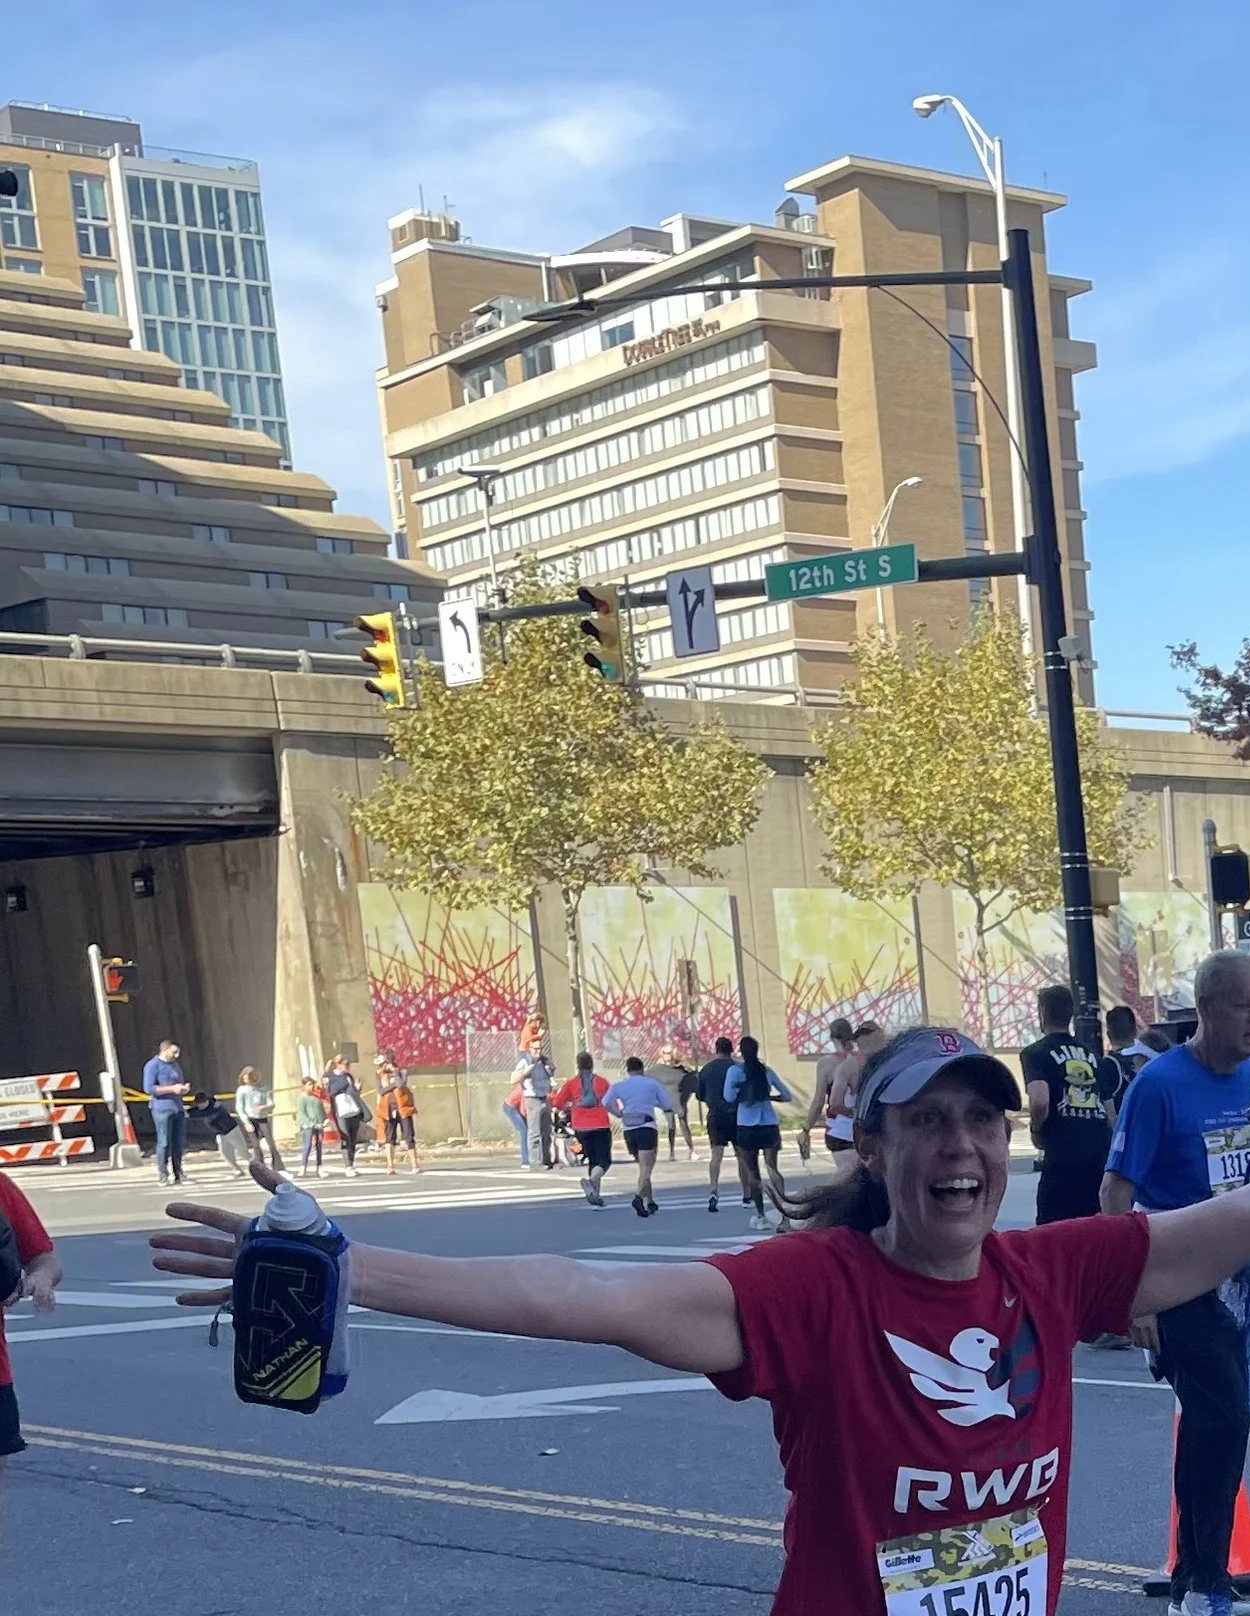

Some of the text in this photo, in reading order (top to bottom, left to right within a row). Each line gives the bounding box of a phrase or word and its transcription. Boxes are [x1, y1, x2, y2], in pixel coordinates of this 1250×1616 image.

[788, 554, 892, 592] 12th St S
[1049, 1045, 1098, 1069] LIMA
[253, 1337, 309, 1381] NATHAN
[893, 1446, 1060, 1514] RWB
[884, 1554, 922, 1569] Gillette
